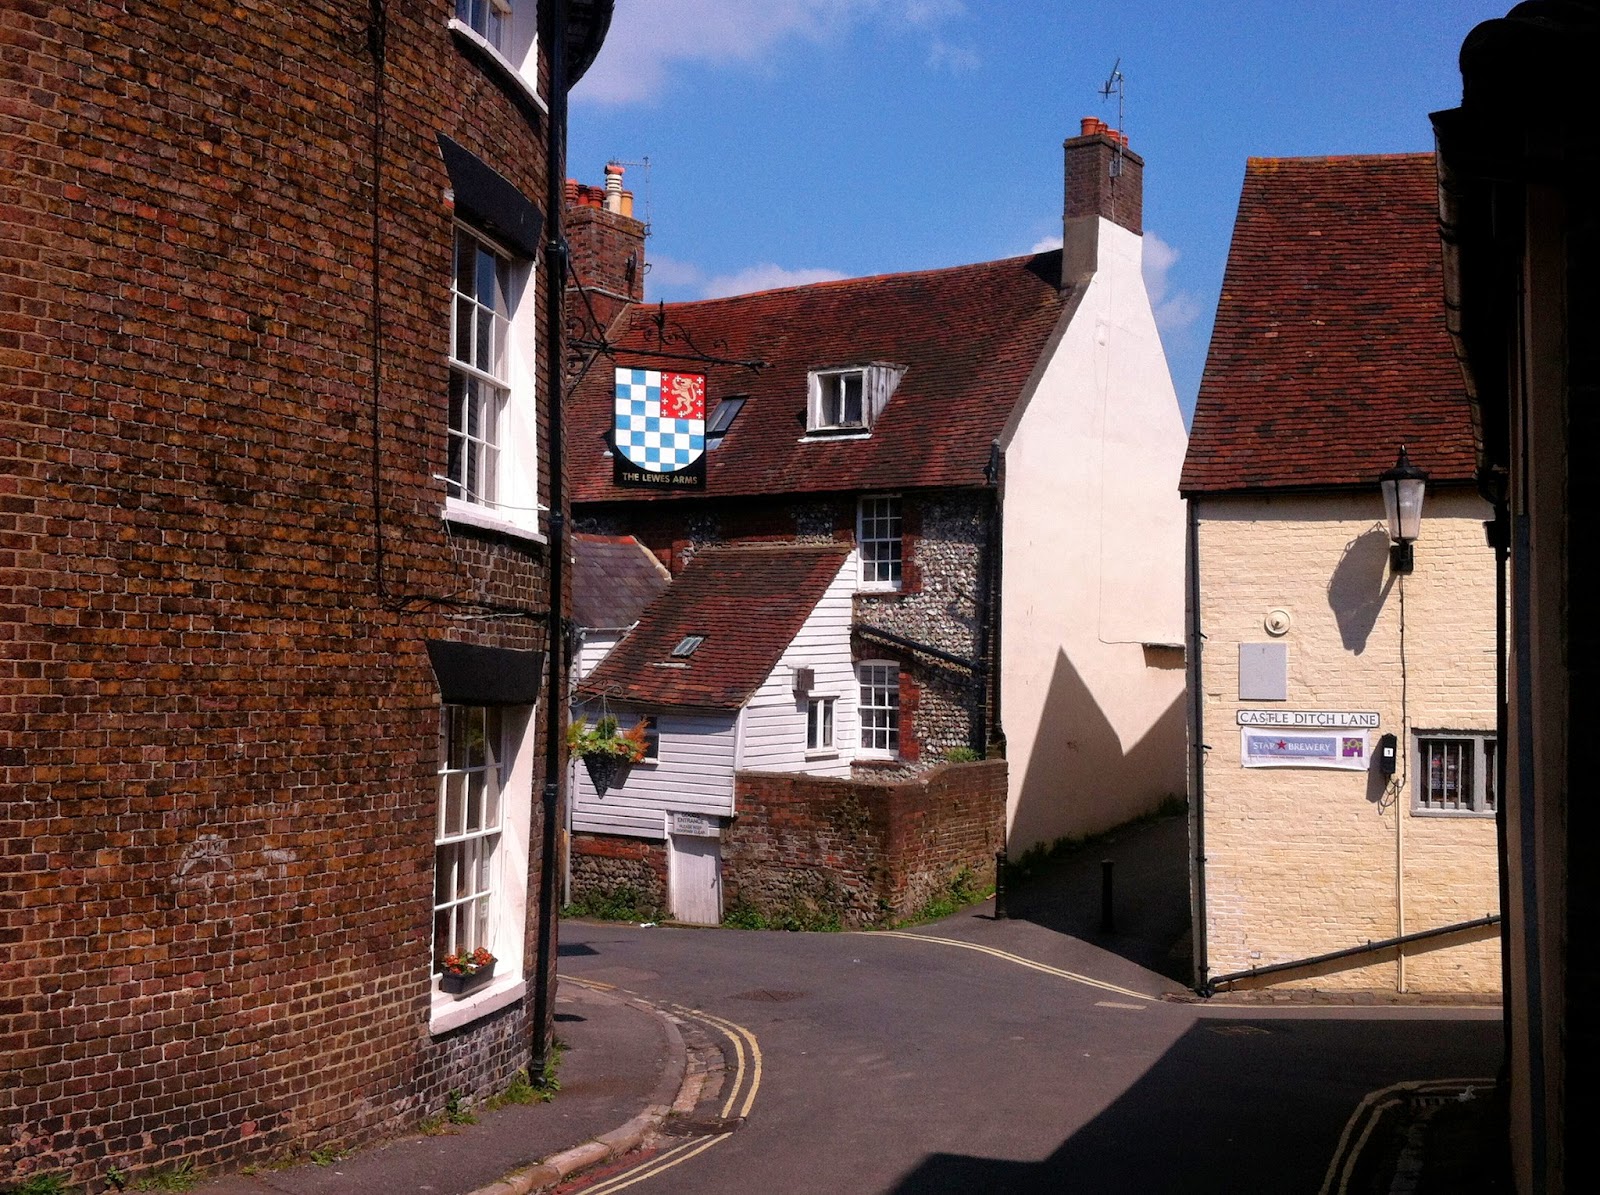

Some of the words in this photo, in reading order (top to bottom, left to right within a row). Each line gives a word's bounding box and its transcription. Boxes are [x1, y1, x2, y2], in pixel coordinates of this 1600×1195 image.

[622, 472, 640, 482] THE
[642, 473, 671, 483] LEWES
[672, 474, 698, 485] ARMS
[1240, 712, 1289, 724] CASTLE
[1294, 713, 1336, 726] DITCH
[1341, 714, 1377, 726] LANE
[1253, 741, 1276, 750] STAR
[1288, 743, 1331, 751] BREWERY
[677, 817, 704, 825] ENTRANCE
